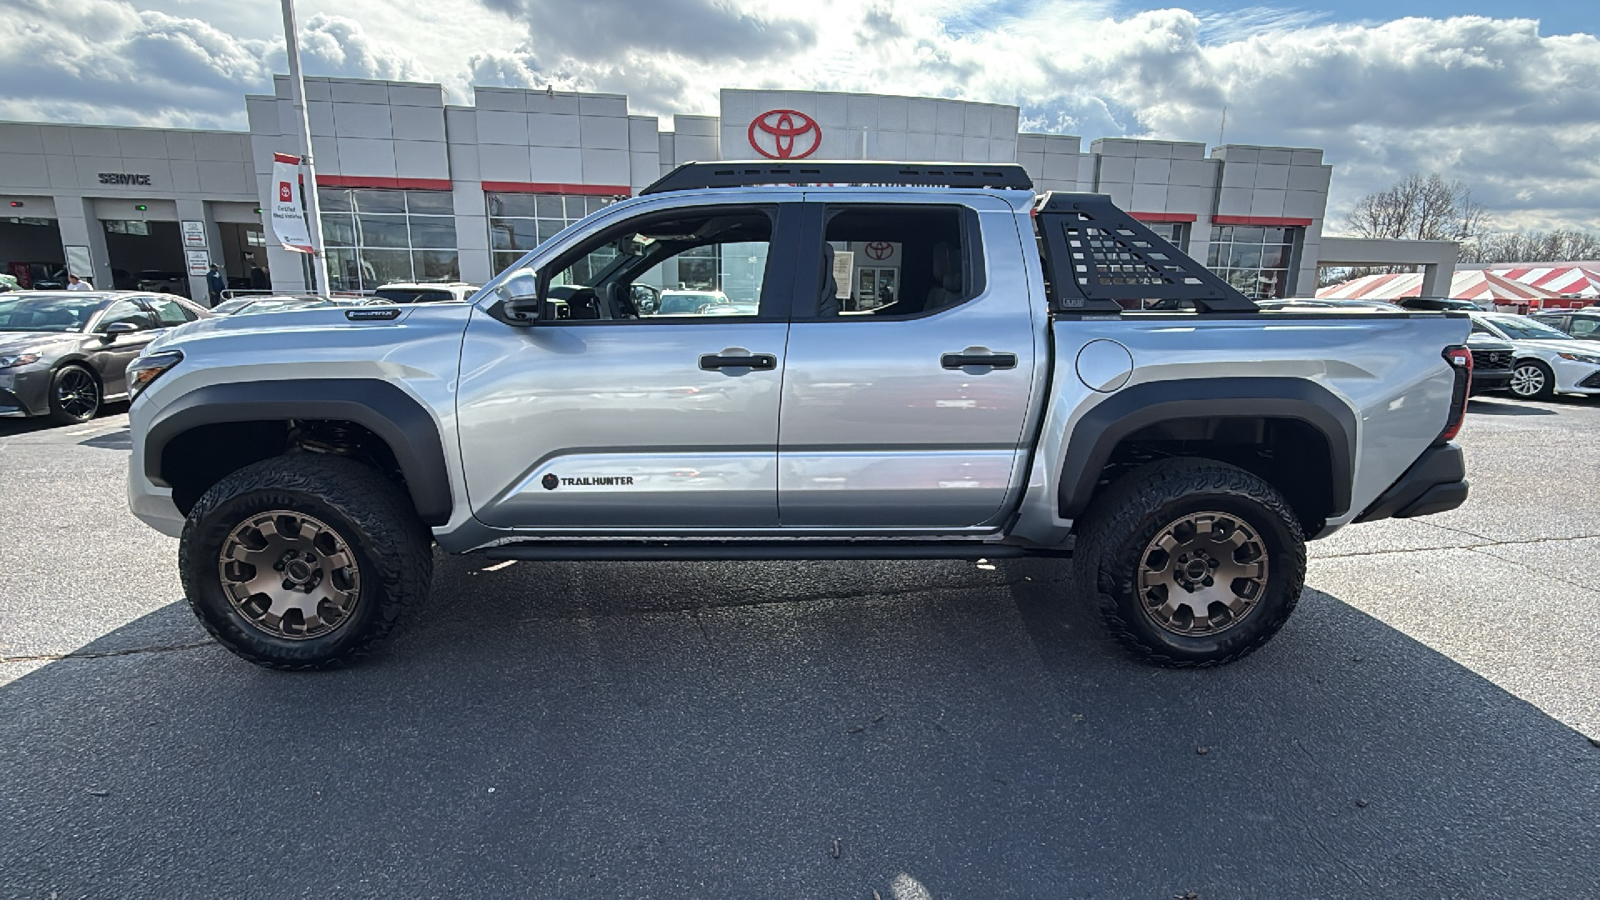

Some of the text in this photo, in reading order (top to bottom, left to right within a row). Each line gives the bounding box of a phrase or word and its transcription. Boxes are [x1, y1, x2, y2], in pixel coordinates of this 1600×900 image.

[98, 173, 152, 186] SERVICE
[277, 205, 296, 213] Certified
[561, 476, 634, 486] TRAILHUNTER
